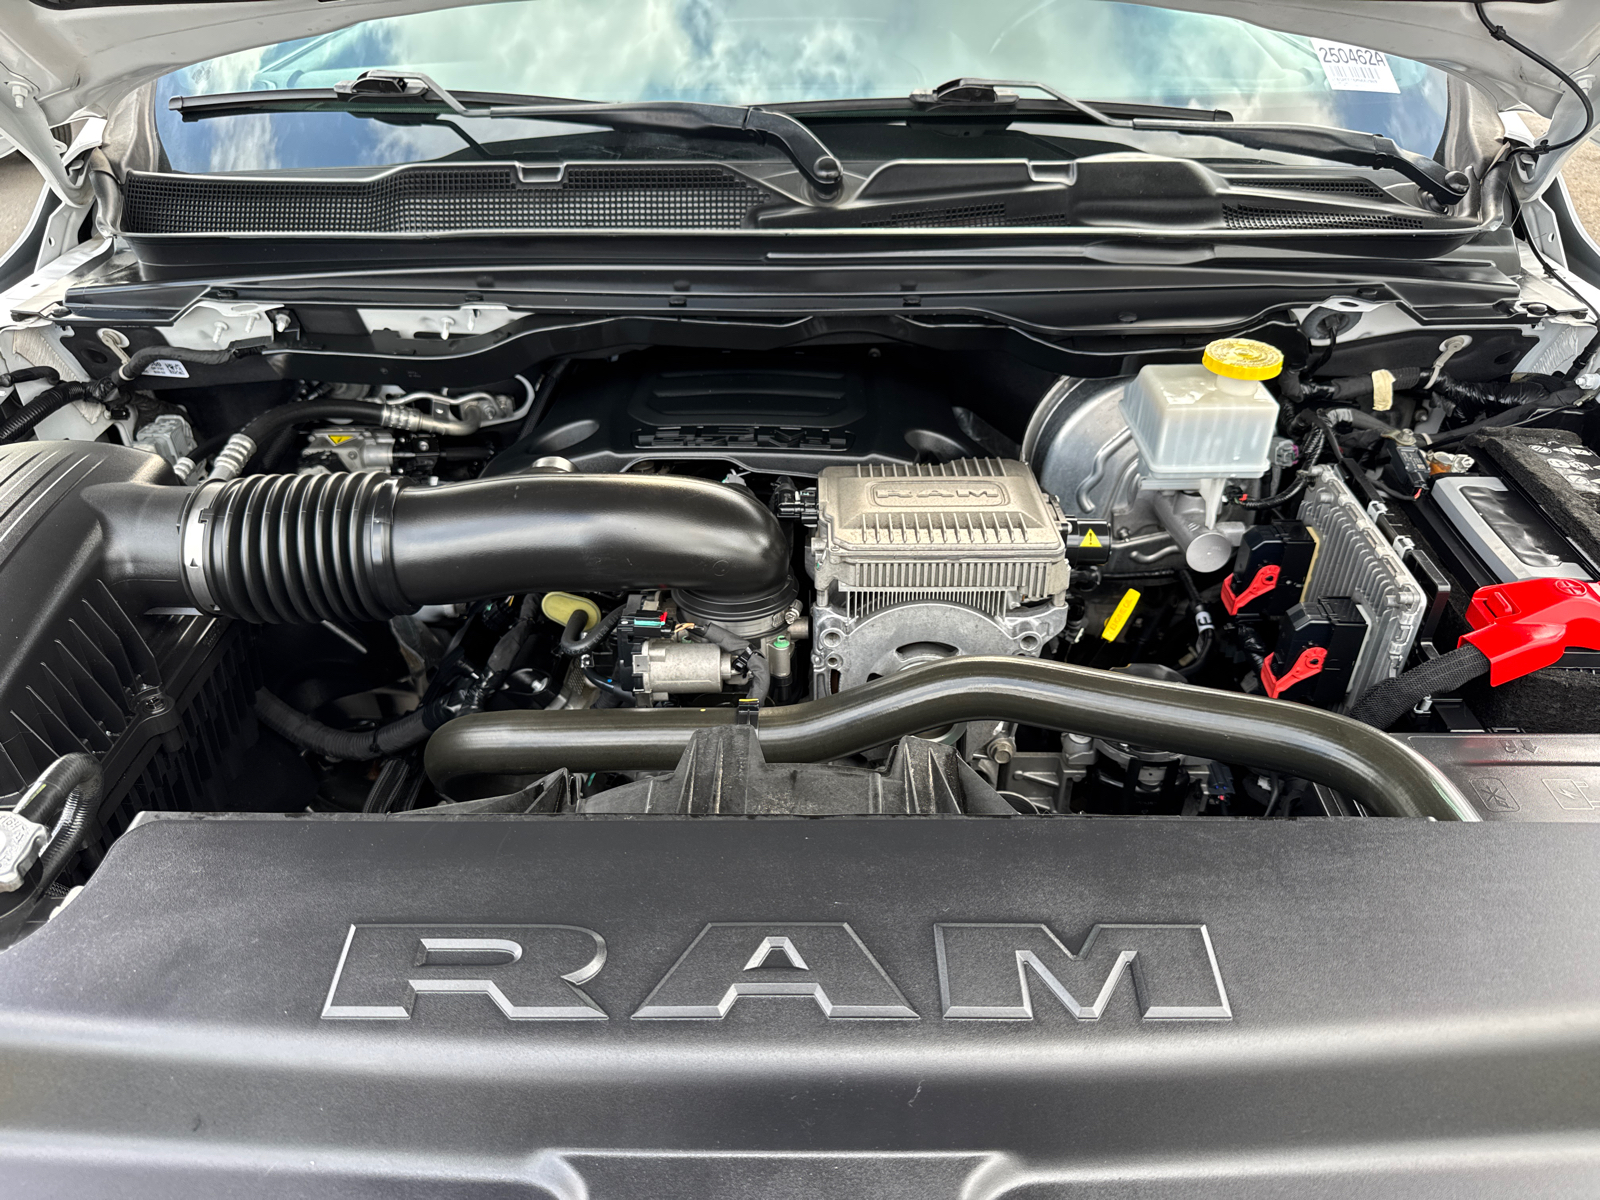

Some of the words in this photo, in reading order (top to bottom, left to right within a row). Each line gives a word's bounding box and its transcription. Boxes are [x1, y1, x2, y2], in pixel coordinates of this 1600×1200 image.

[1319, 47, 1386, 67] 250462A
[875, 489, 999, 498] RAM
[321, 922, 1233, 1022] RAM
